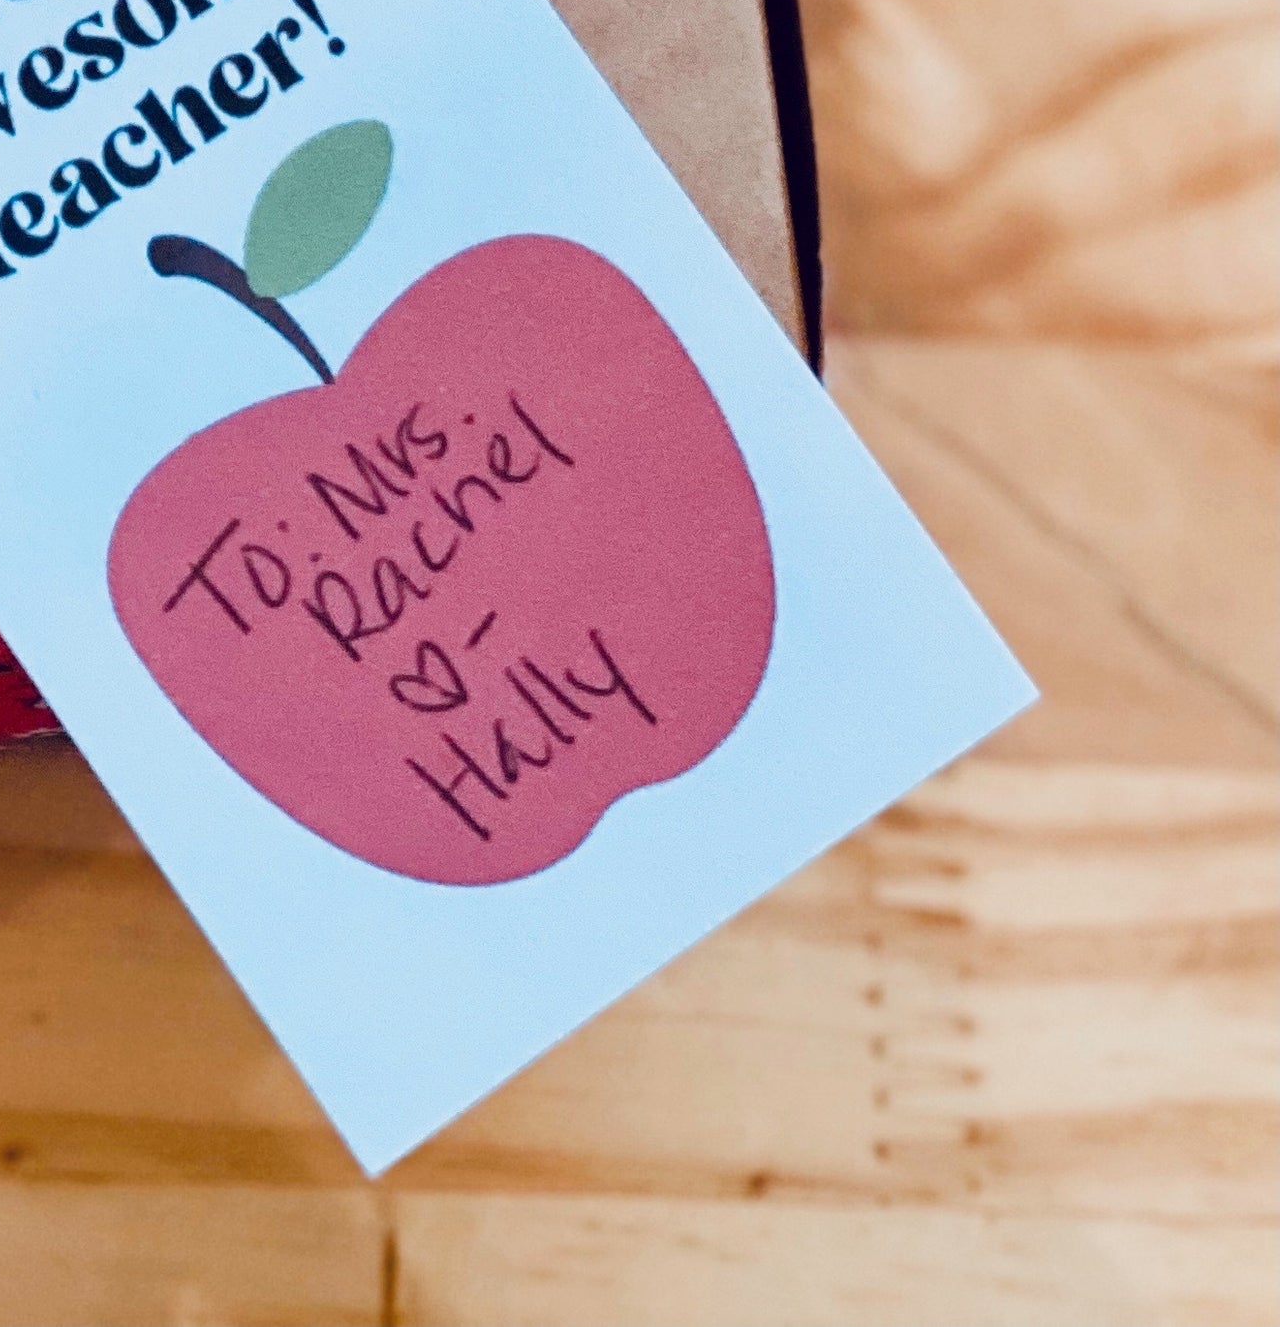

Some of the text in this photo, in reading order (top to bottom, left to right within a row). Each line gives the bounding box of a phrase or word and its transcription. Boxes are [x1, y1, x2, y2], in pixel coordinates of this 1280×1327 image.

[302, 393, 574, 662] Rachel
[306, 403, 475, 539] Mrs.
[405, 629, 656, 840] Hally
